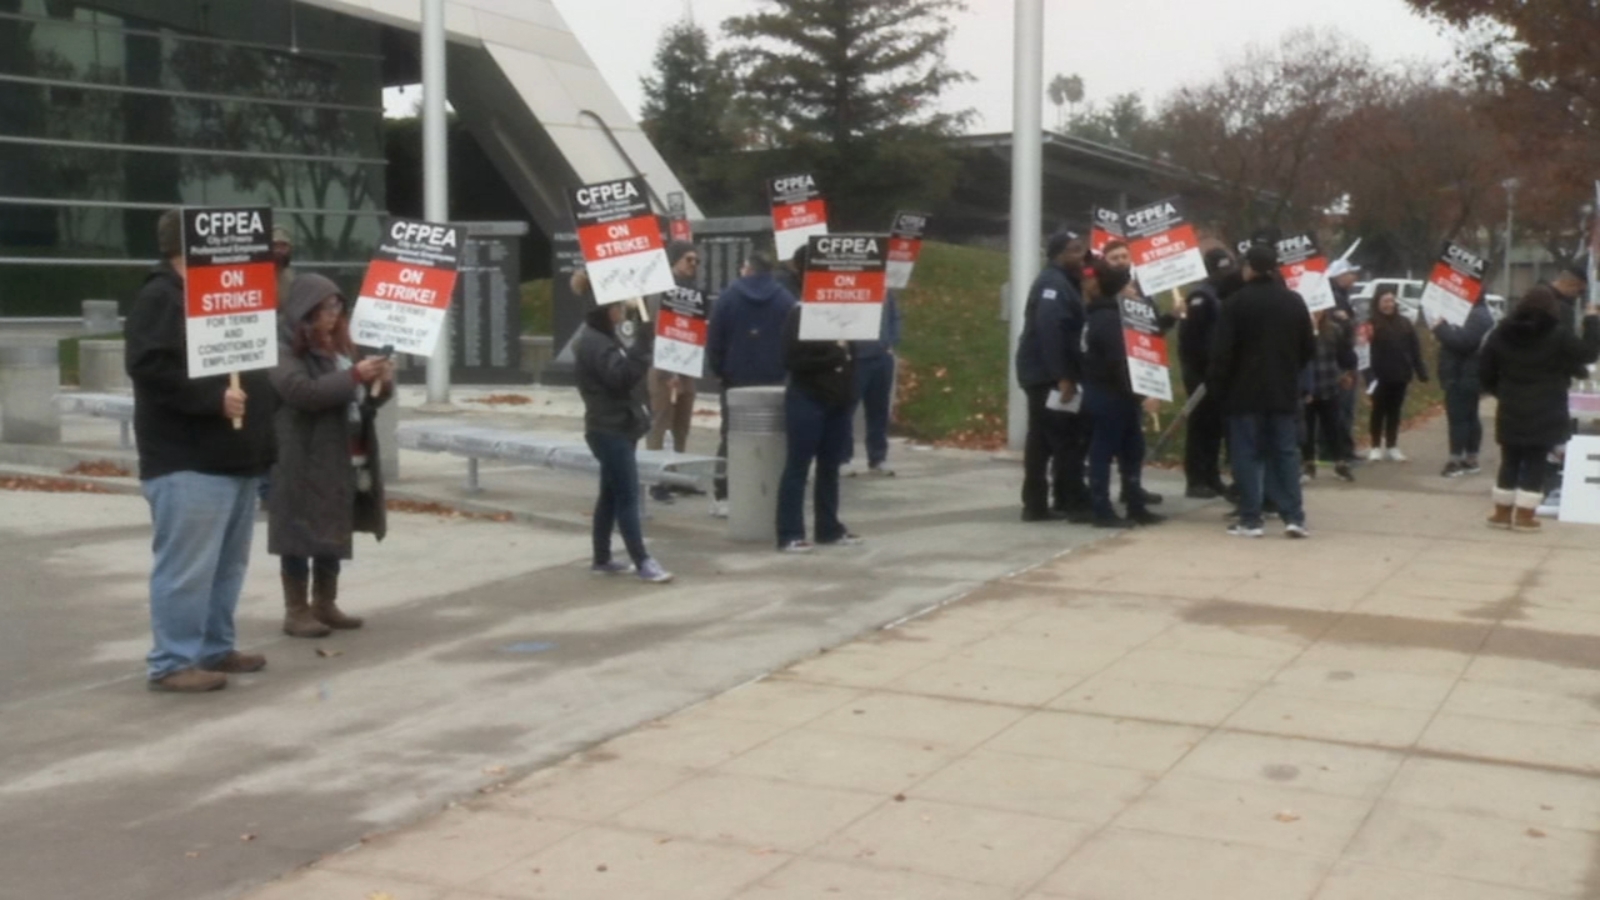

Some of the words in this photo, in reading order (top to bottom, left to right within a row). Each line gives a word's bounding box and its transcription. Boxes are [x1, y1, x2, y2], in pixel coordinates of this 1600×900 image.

[576, 181, 638, 205] CFPEA
[1098, 208, 1119, 222] CFP
[1126, 202, 1177, 227] CFPEA
[195, 211, 264, 236] CFPEA
[607, 224, 630, 239] ON
[390, 221, 457, 248] CFPEA
[1151, 234, 1169, 247] ON
[595, 236, 650, 257] STRIKE!
[816, 238, 879, 254] CFPEA
[1276, 235, 1312, 252] FPEA
[1448, 244, 1484, 271] CFPEA
[220, 270, 244, 288] ON
[399, 268, 424, 284] ON
[834, 275, 856, 287] ON
[201, 290, 263, 311] STRIKE!
[375, 282, 437, 304] STRIKE!
[816, 289, 871, 301] STRIKE!
[206, 317, 226, 328] FOR
[229, 314, 259, 325] TERMS
[224, 328, 244, 338] AND
[198, 340, 255, 355] CONDITIONS
[256, 338, 267, 349] OF
[202, 351, 265, 368] EMPLOYMENT
